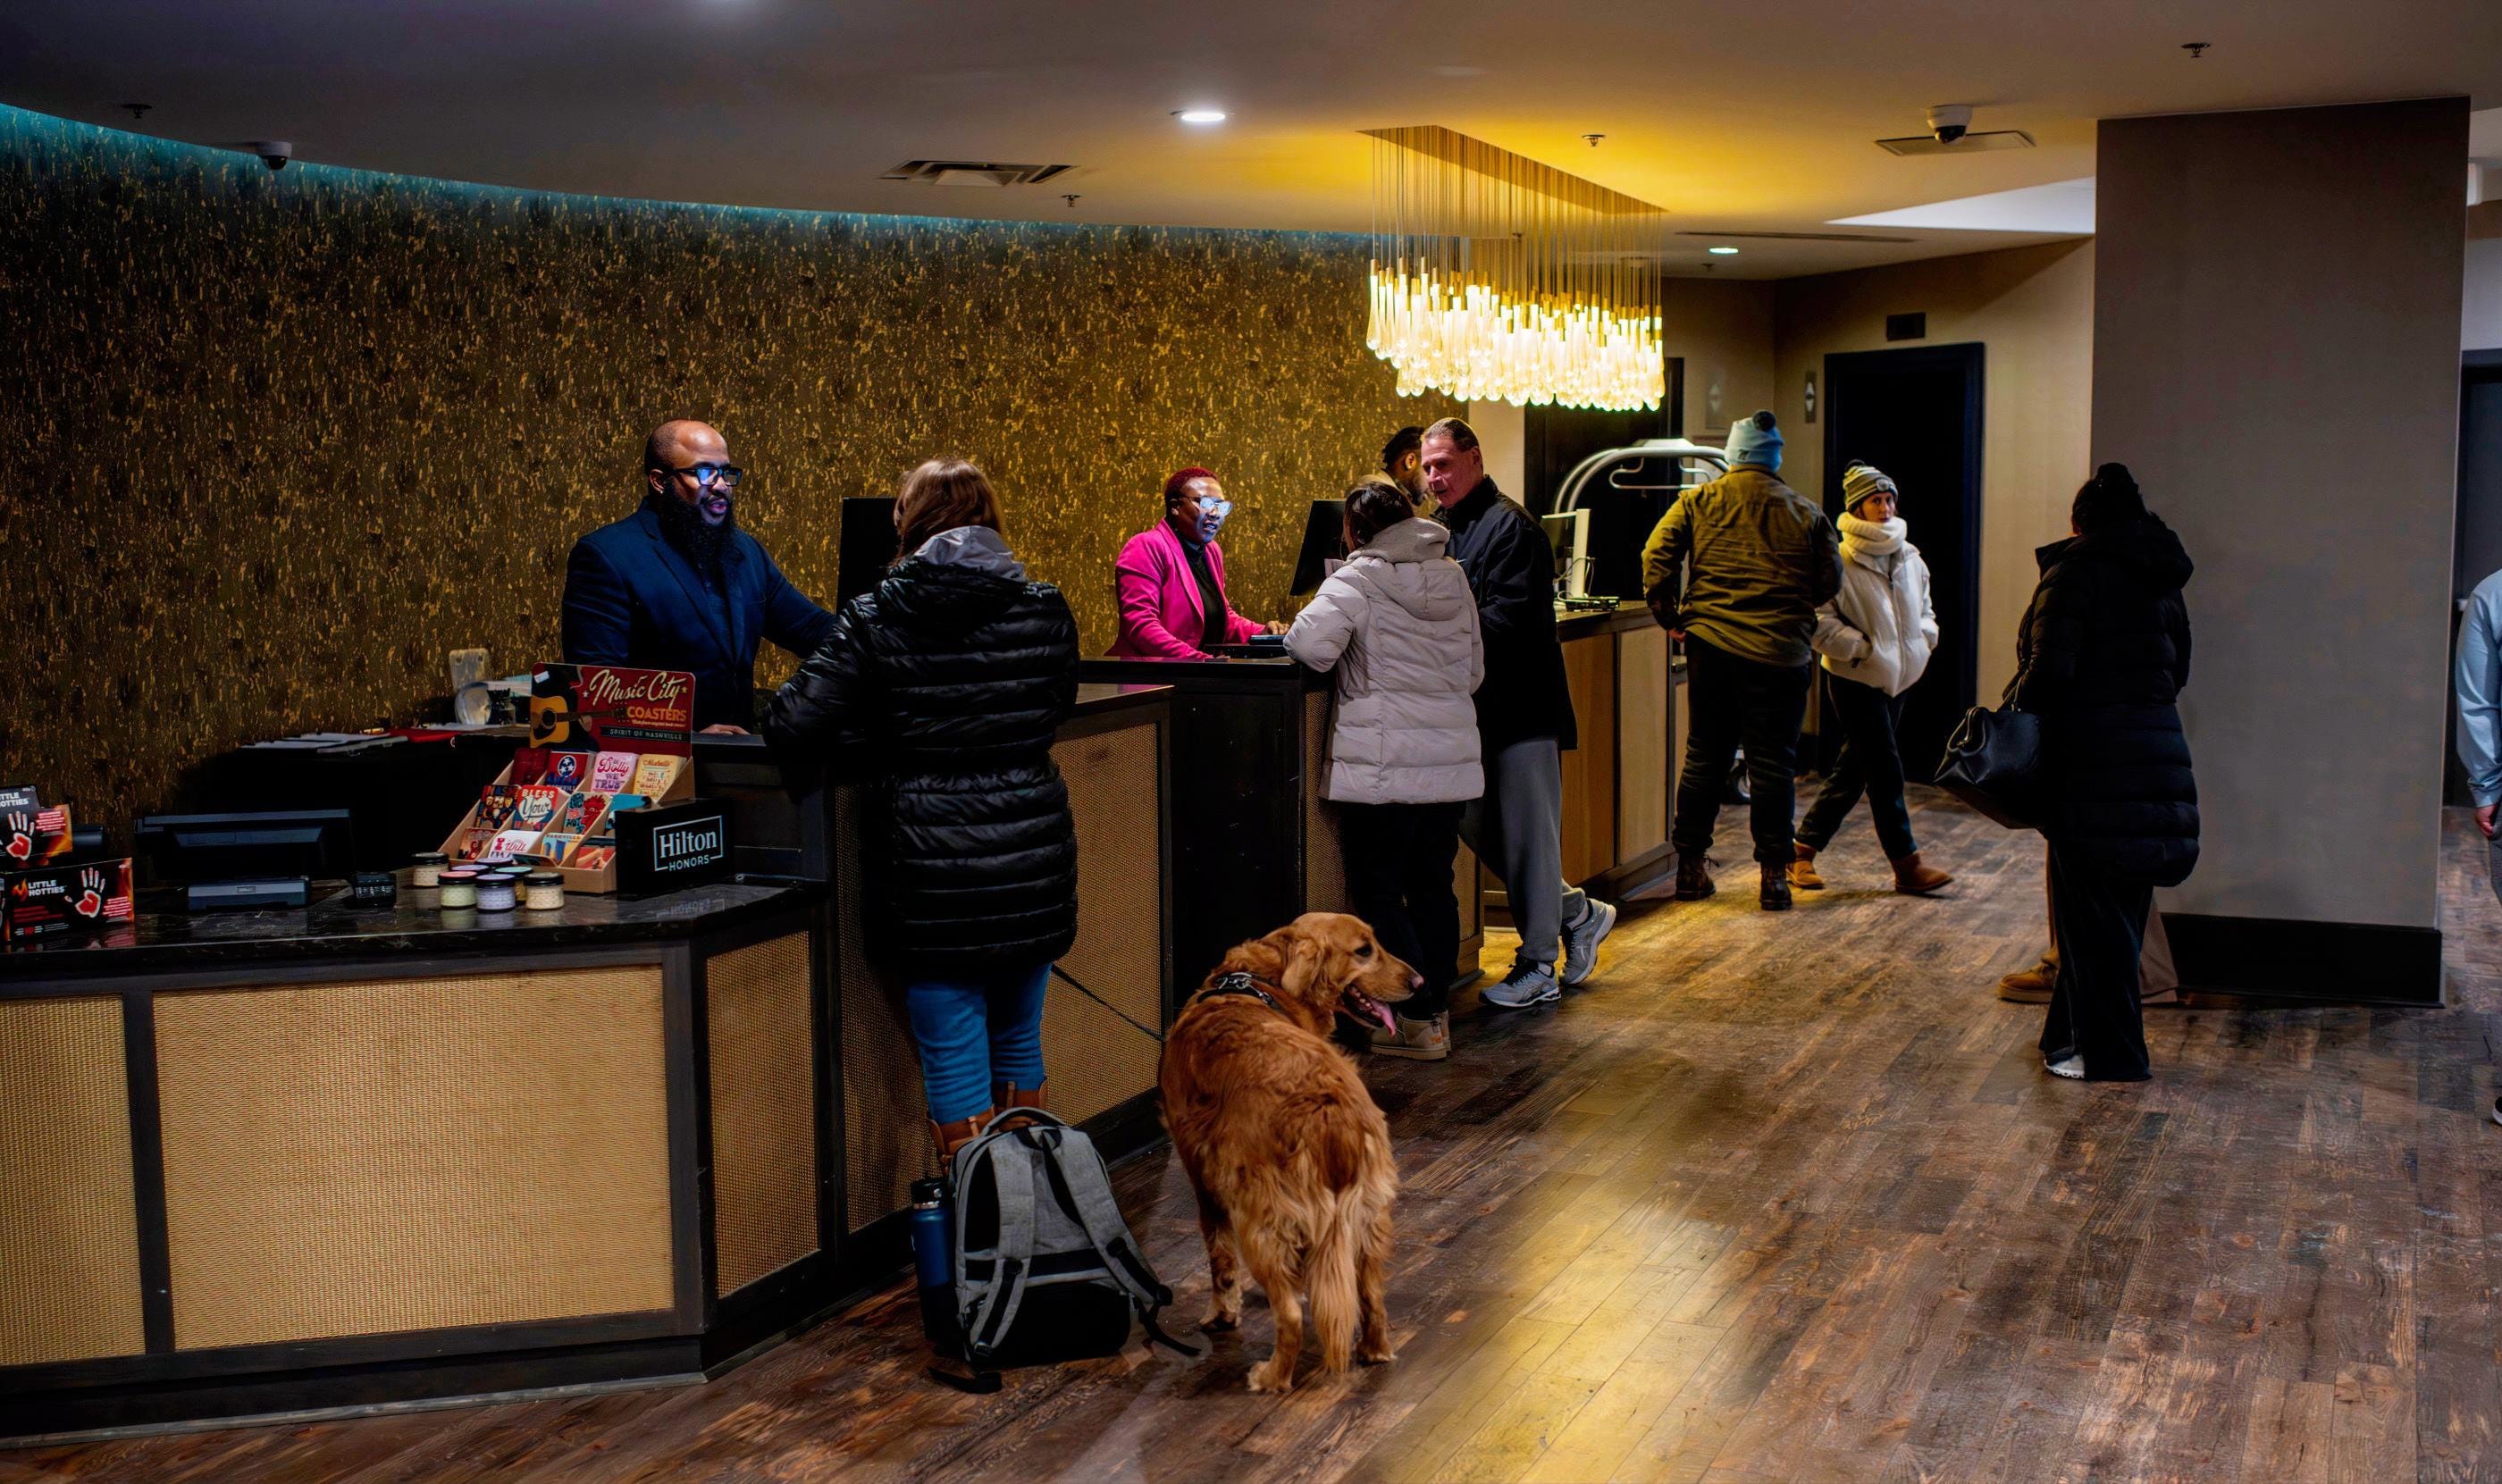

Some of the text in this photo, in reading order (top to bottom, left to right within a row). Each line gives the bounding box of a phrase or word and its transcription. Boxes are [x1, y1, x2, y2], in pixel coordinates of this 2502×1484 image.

[590, 669, 686, 708] Music City
[627, 706, 686, 721] COASTERS
[644, 731, 683, 741] NASHVILLE
[598, 757, 629, 776] Dolly
[0, 792, 21, 801] TTLE
[521, 788, 556, 799] BLESS
[0, 797, 29, 808] OTTIES
[522, 796, 550, 820] Your
[659, 831, 718, 858] Hilton
[669, 855, 709, 871] HONORS
[29, 880, 56, 889] LITTLE
[29, 886, 65, 897] HOTTIES
